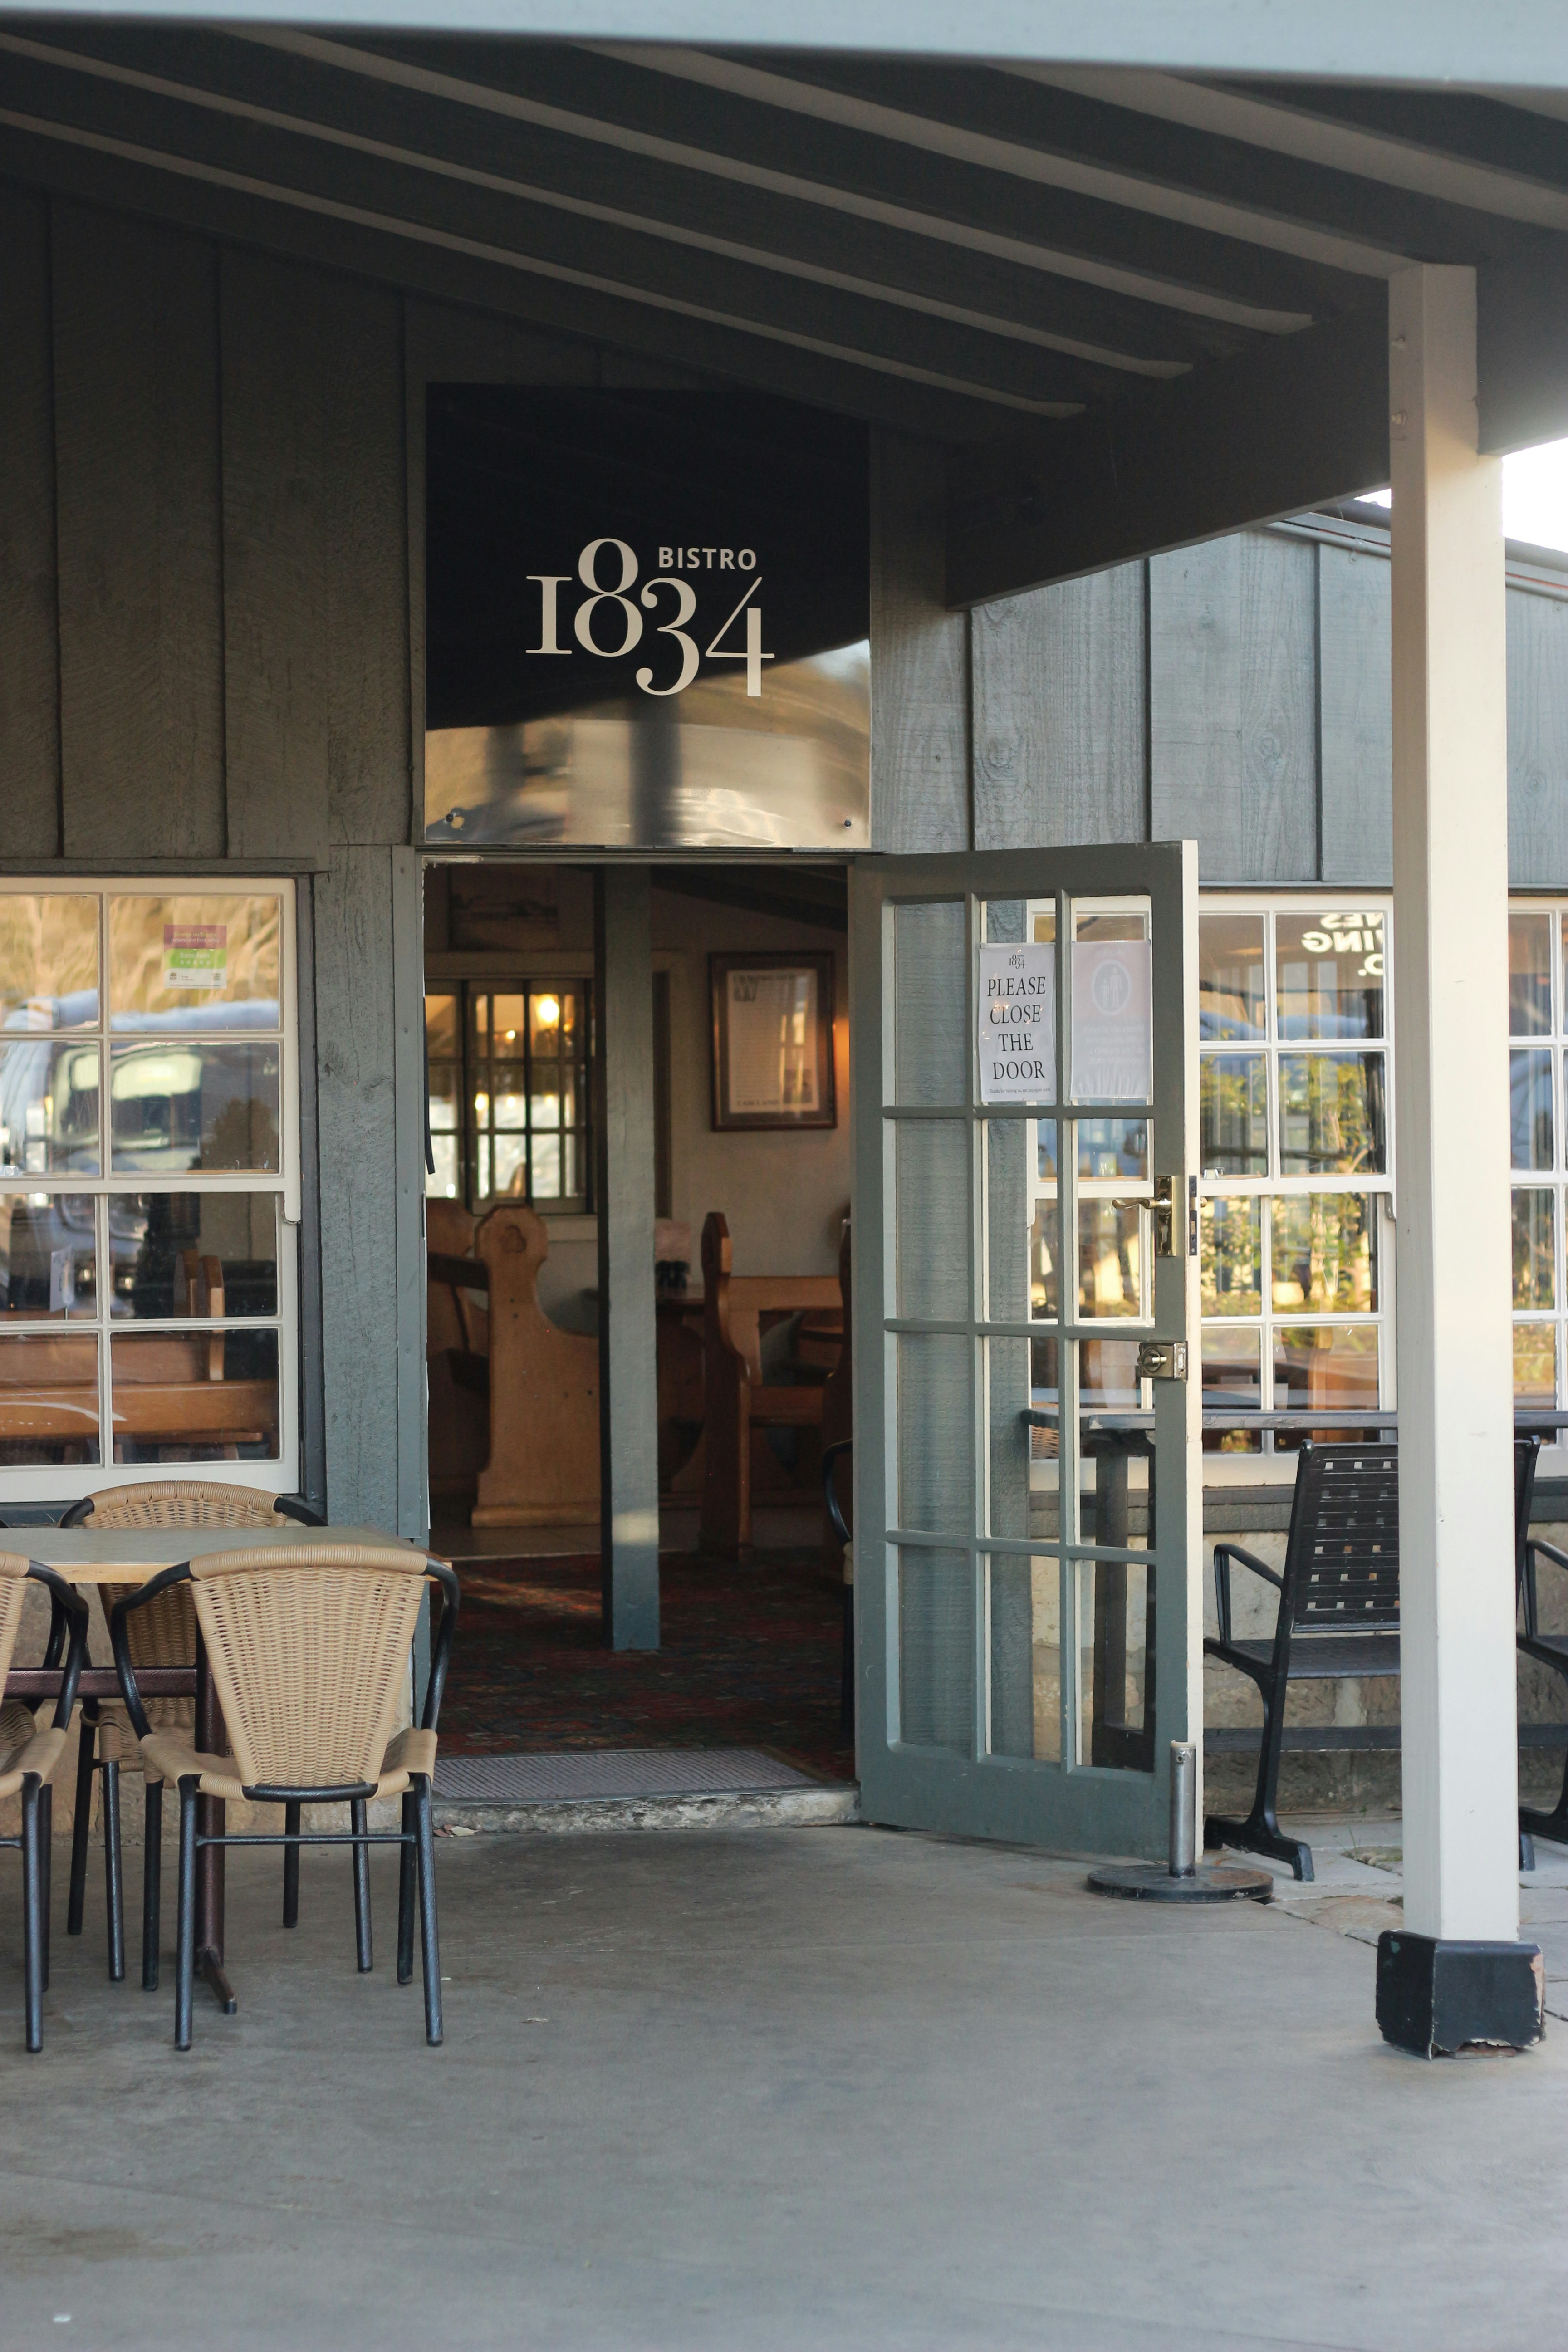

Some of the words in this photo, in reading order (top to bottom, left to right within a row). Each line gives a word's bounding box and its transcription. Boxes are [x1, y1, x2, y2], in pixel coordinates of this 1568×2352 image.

[659, 547, 756, 570] BISTRO
[525, 538, 775, 696] 1834
[1009, 954, 1025, 969] 1834
[987, 976, 1046, 996] PLEASE
[990, 1004, 1041, 1024] CLOSE
[998, 1033, 1034, 1051] THE
[992, 1061, 1045, 1080] DOOR
